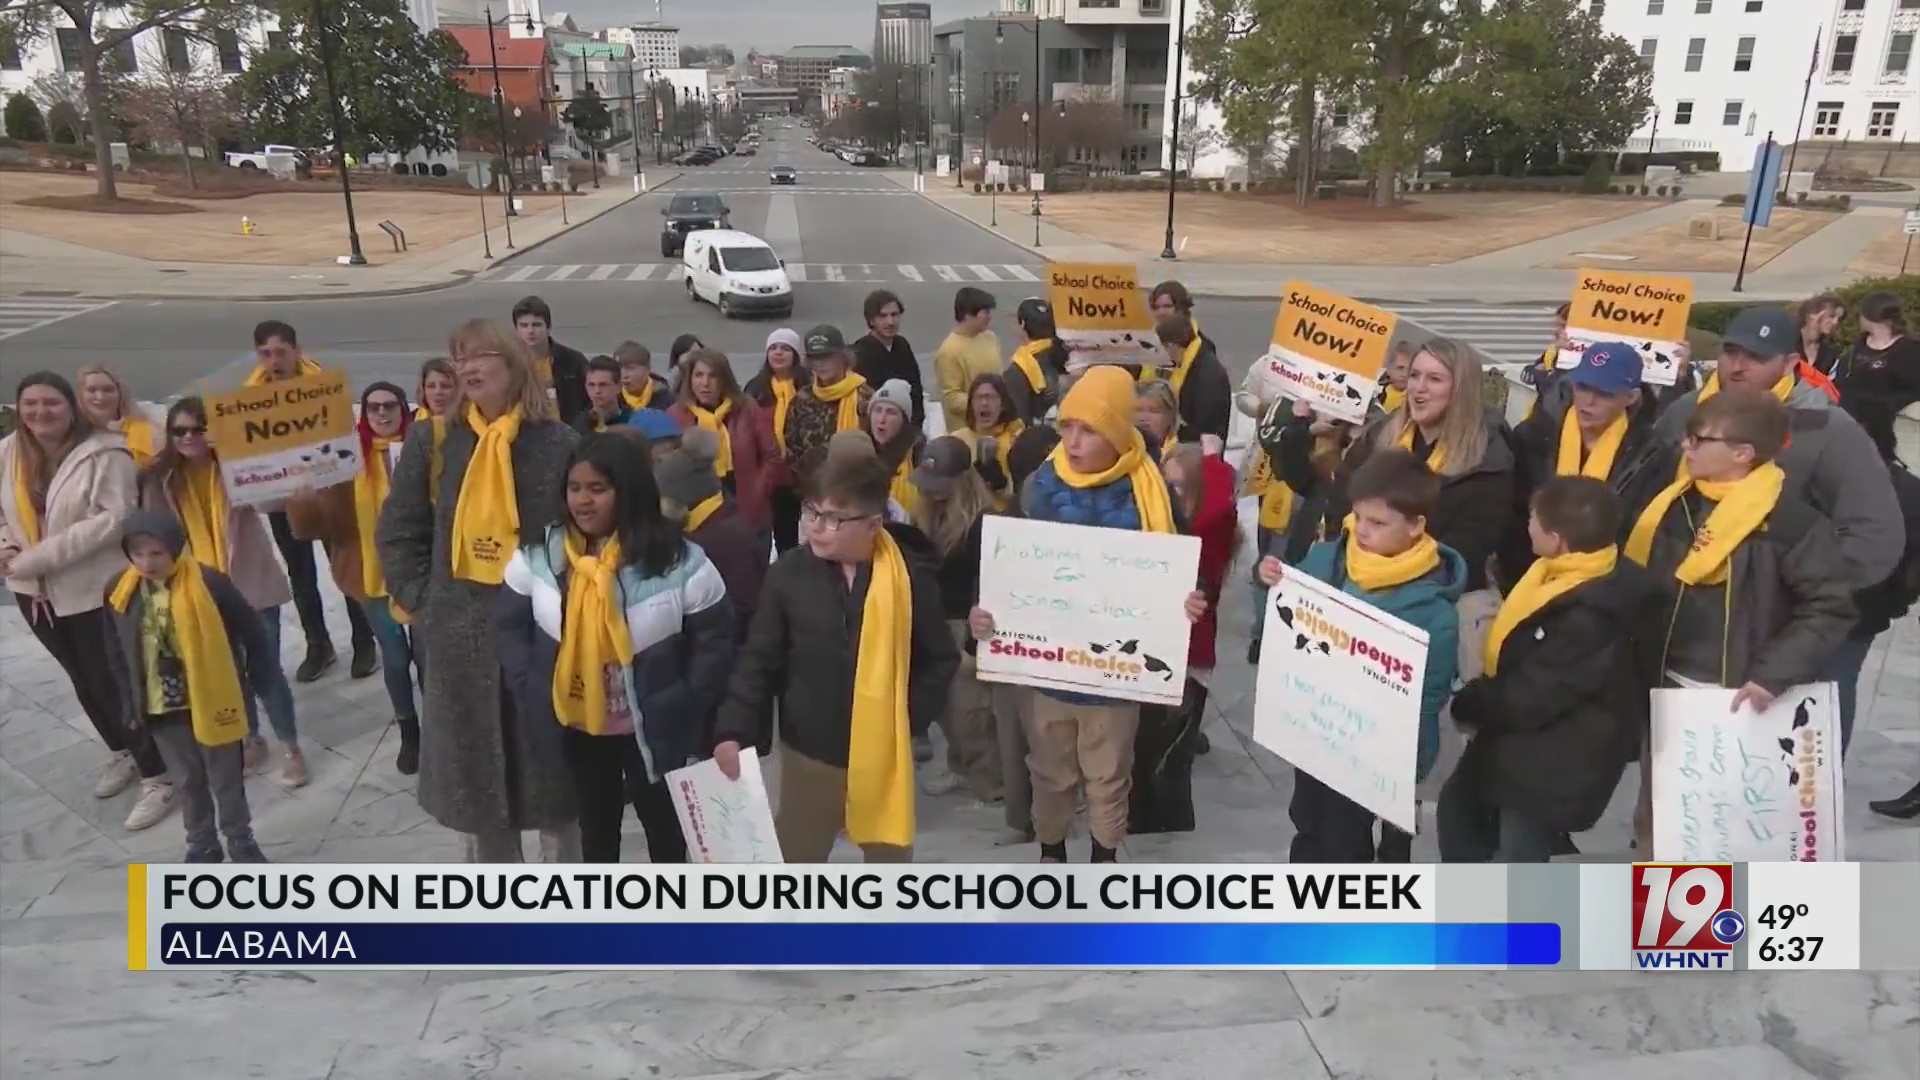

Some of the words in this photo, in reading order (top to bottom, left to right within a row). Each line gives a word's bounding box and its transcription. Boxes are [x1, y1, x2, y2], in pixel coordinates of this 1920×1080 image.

[1052, 273, 1088, 288] School
[1092, 275, 1135, 290] Choice
[1581, 277, 1631, 295] School
[1634, 284, 1686, 303] Choice
[1068, 296, 1126, 318] Now!
[1288, 291, 1335, 318] School
[1336, 308, 1388, 335] Choice
[1591, 300, 1664, 327] Now!
[1293, 318, 1363, 358] Now!
[215, 391, 280, 418] School
[285, 383, 344, 405] Choice
[245, 405, 329, 444] Now!
[1737, 737, 1780, 842] FIRST
